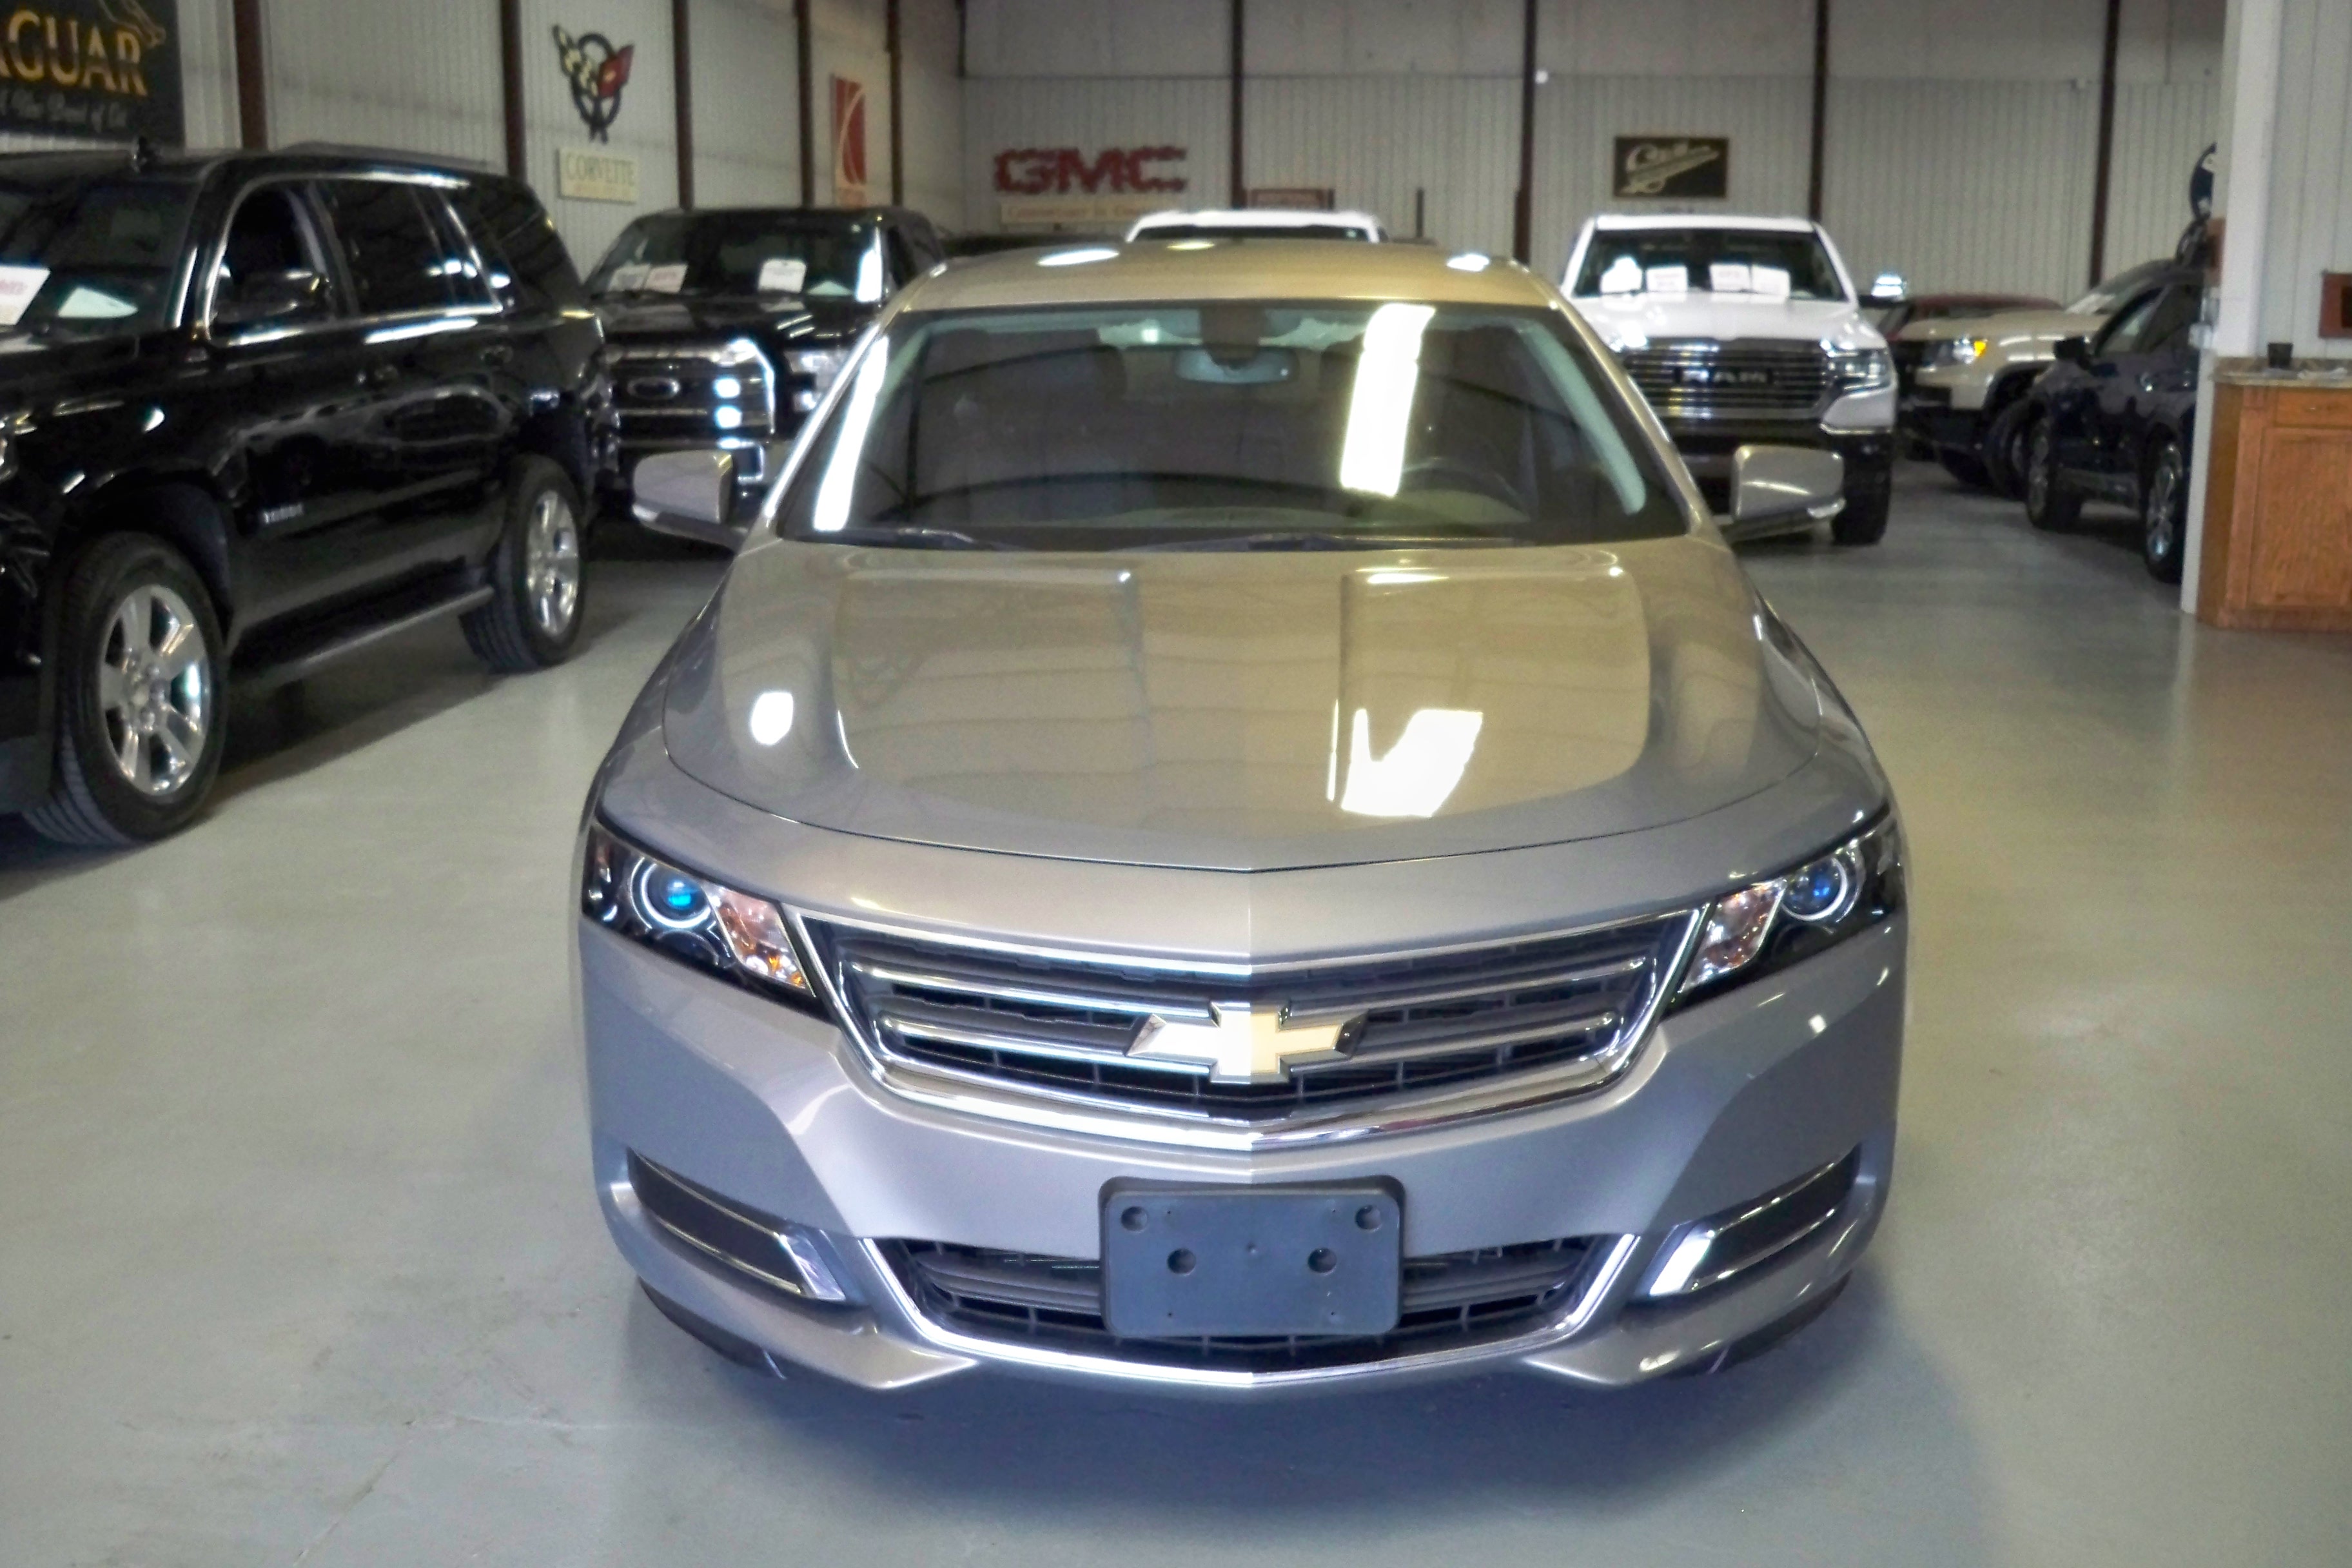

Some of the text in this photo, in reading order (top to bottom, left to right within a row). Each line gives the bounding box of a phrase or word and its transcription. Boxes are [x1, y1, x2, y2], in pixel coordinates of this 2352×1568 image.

[0, 8, 148, 96] GUAR
[994, 146, 1186, 193] GMC
[1682, 370, 1767, 382] RAM
